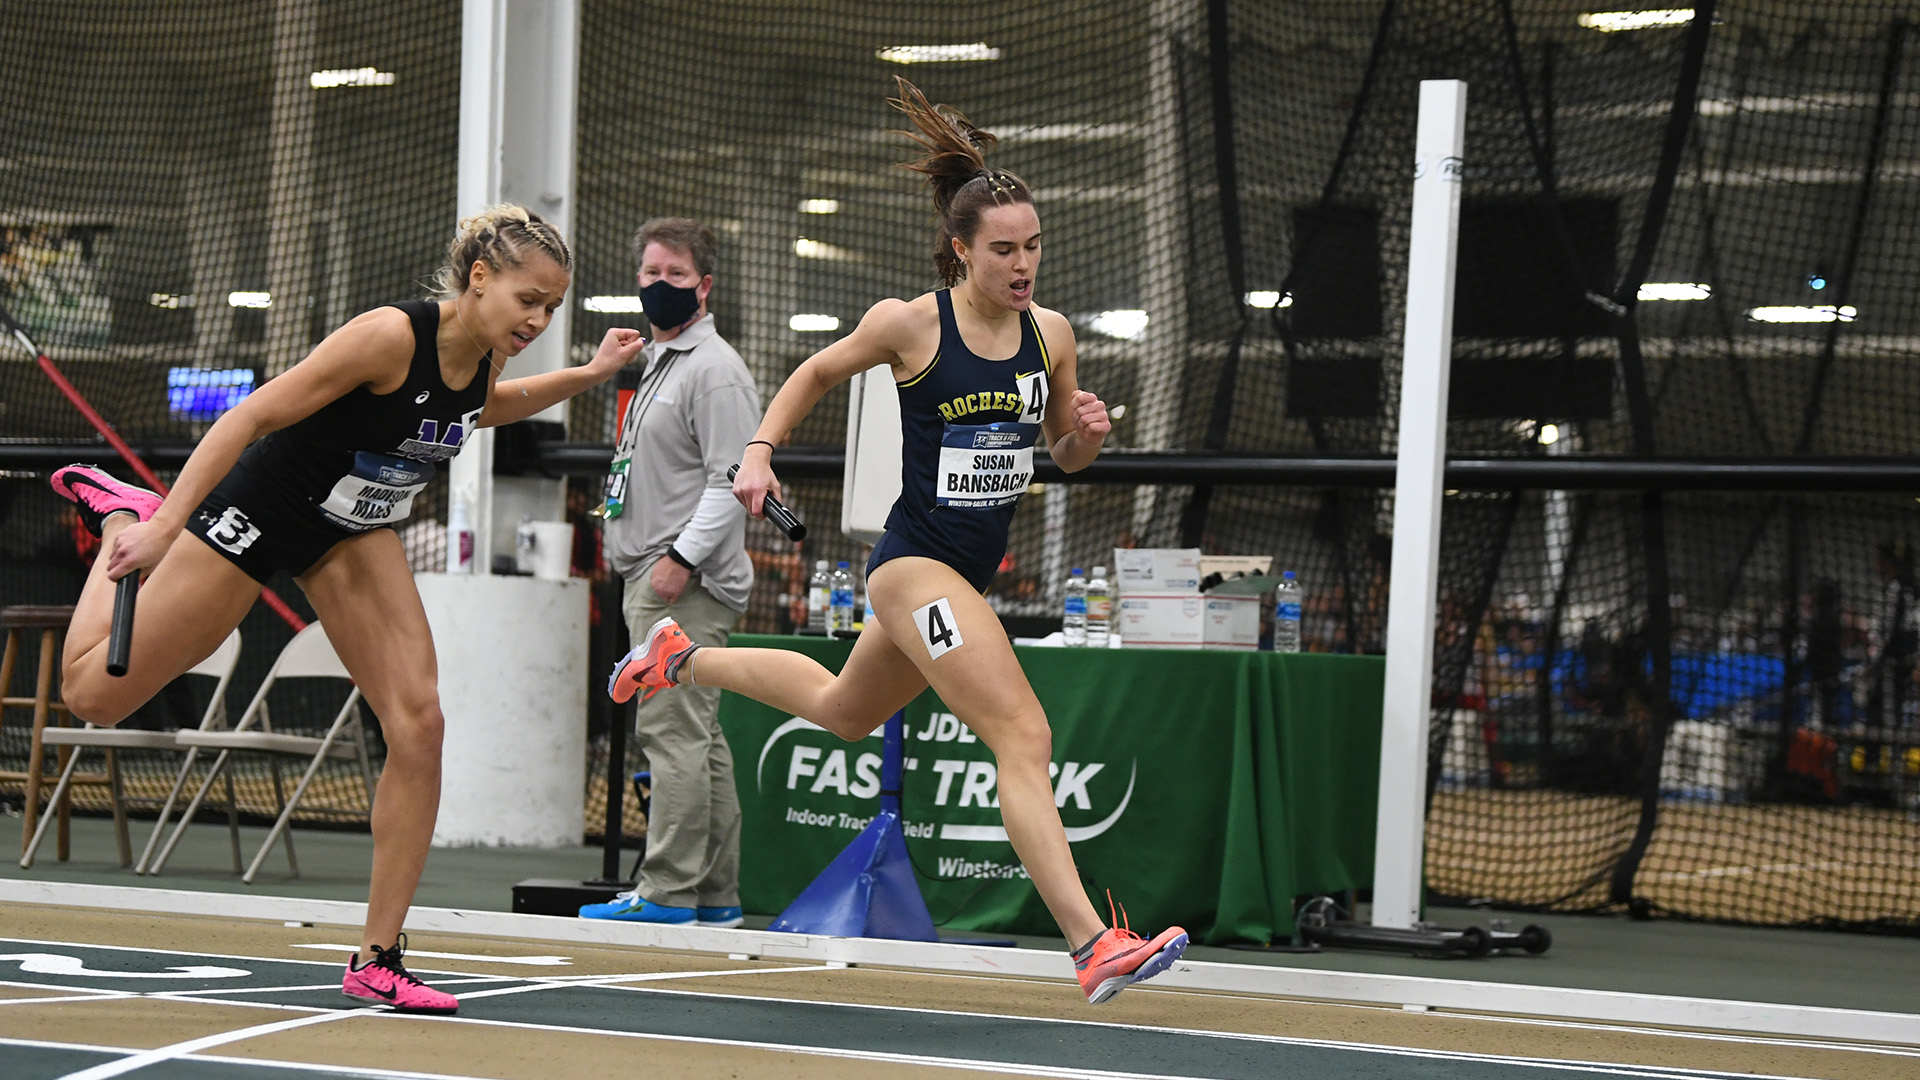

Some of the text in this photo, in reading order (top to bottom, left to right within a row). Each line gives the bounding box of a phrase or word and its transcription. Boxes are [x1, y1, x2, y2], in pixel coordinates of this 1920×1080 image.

[1027, 376, 1044, 421] 4
[972, 454, 1015, 470] SUSAN
[357, 485, 412, 503] MADISON
[947, 472, 1028, 493] BANSBACH
[215, 513, 250, 546] 3
[929, 604, 954, 649] 4
[917, 712, 977, 743] JDL
[933, 759, 1105, 810] TRK
[786, 807, 935, 839] Indoor Trac ield
